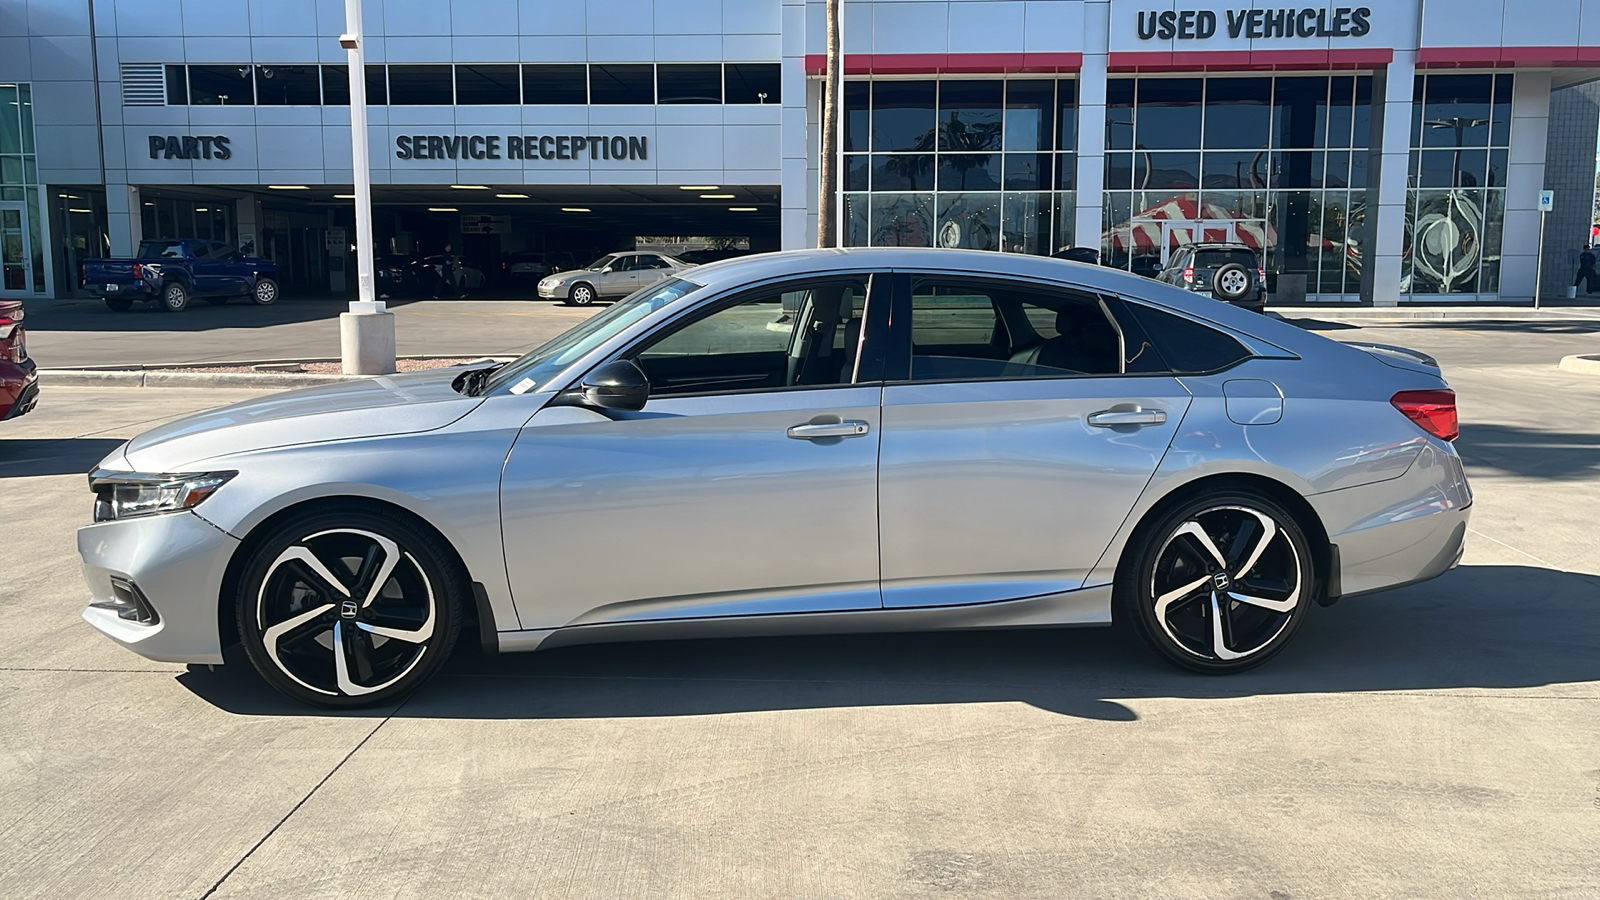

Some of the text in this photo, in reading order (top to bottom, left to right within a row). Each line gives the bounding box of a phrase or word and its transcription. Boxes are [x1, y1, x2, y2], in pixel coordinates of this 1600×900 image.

[1137, 8, 1371, 40] USED VEHICLES
[148, 135, 231, 160] PARTS
[396, 135, 648, 160] SERVICE RECEPTION
